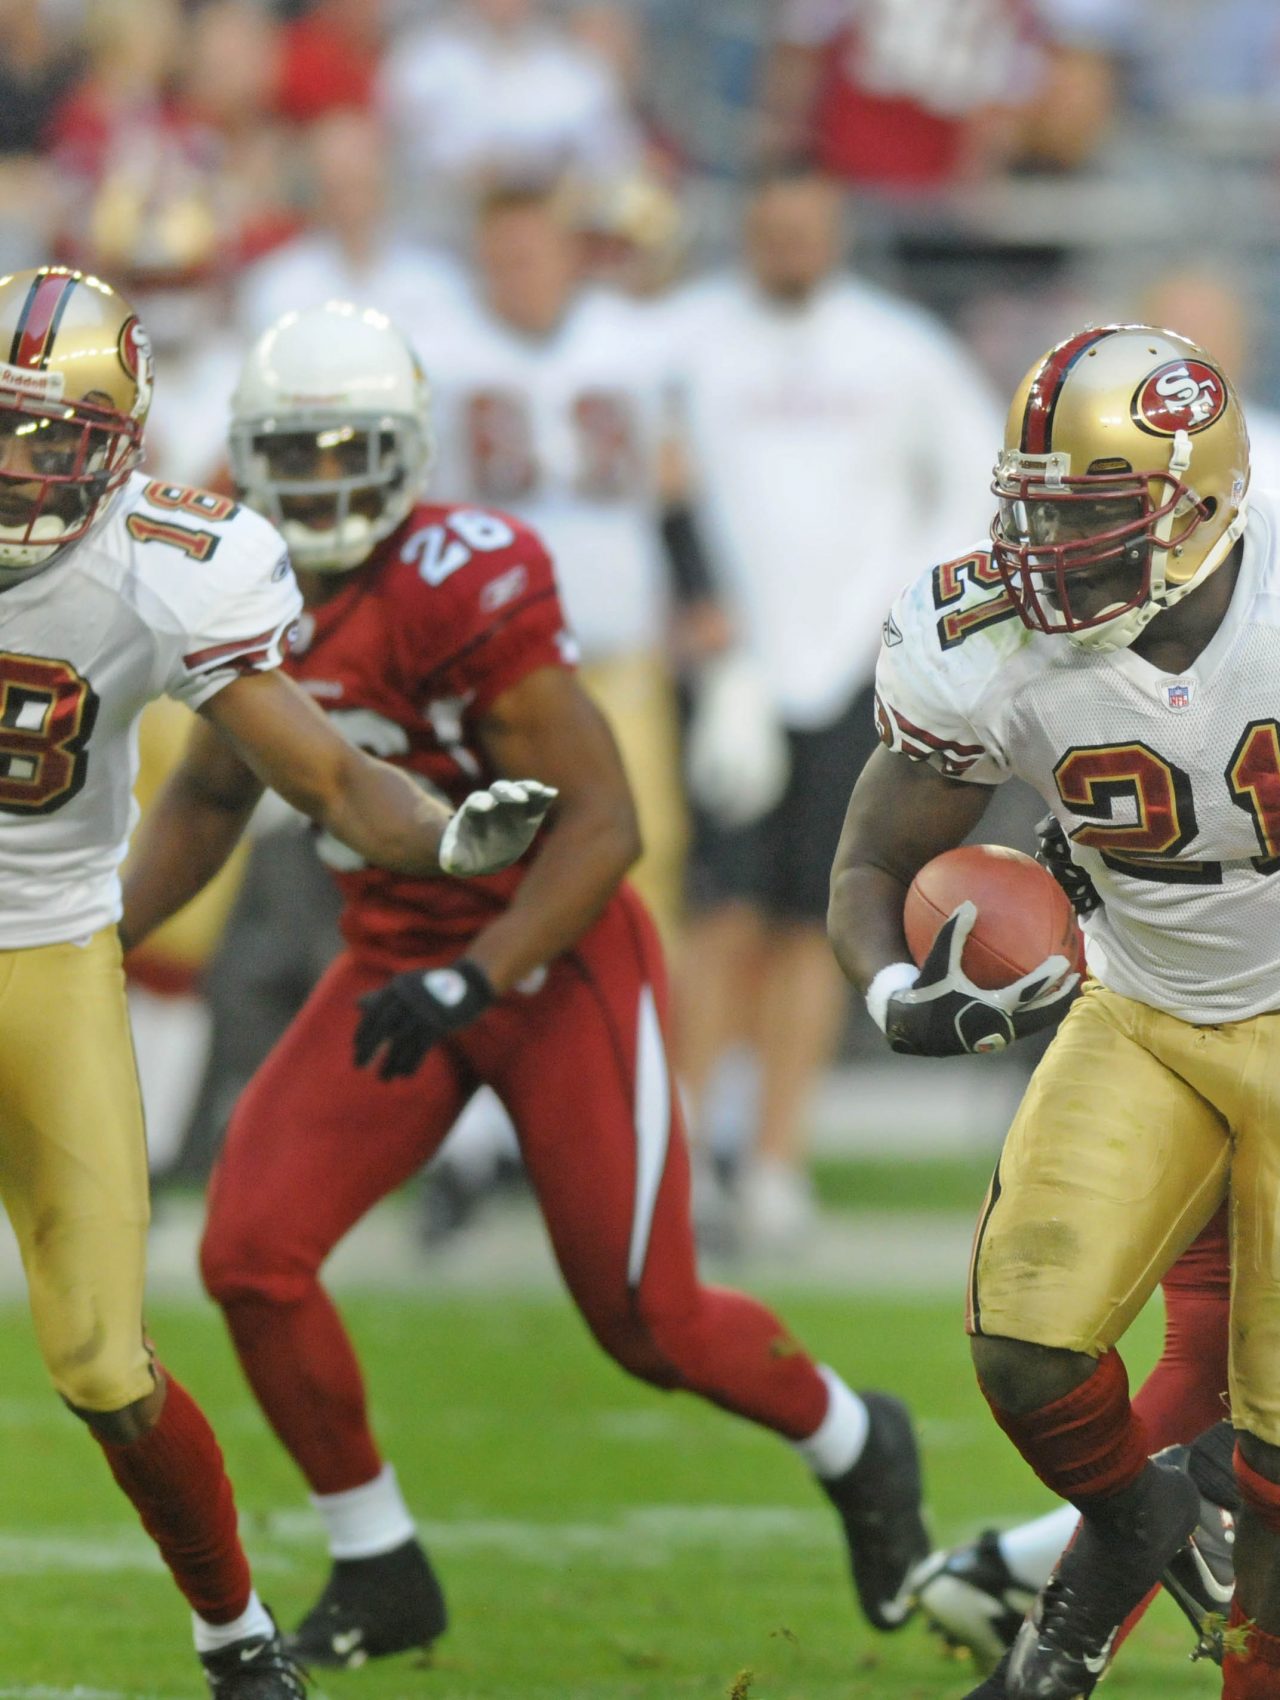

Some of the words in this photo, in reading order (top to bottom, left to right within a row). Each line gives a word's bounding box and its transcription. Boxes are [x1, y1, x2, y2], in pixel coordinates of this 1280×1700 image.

[1155, 367, 1217, 427] SF
[126, 480, 241, 564] 18
[399, 508, 516, 587] 26
[932, 550, 1026, 652] 21
